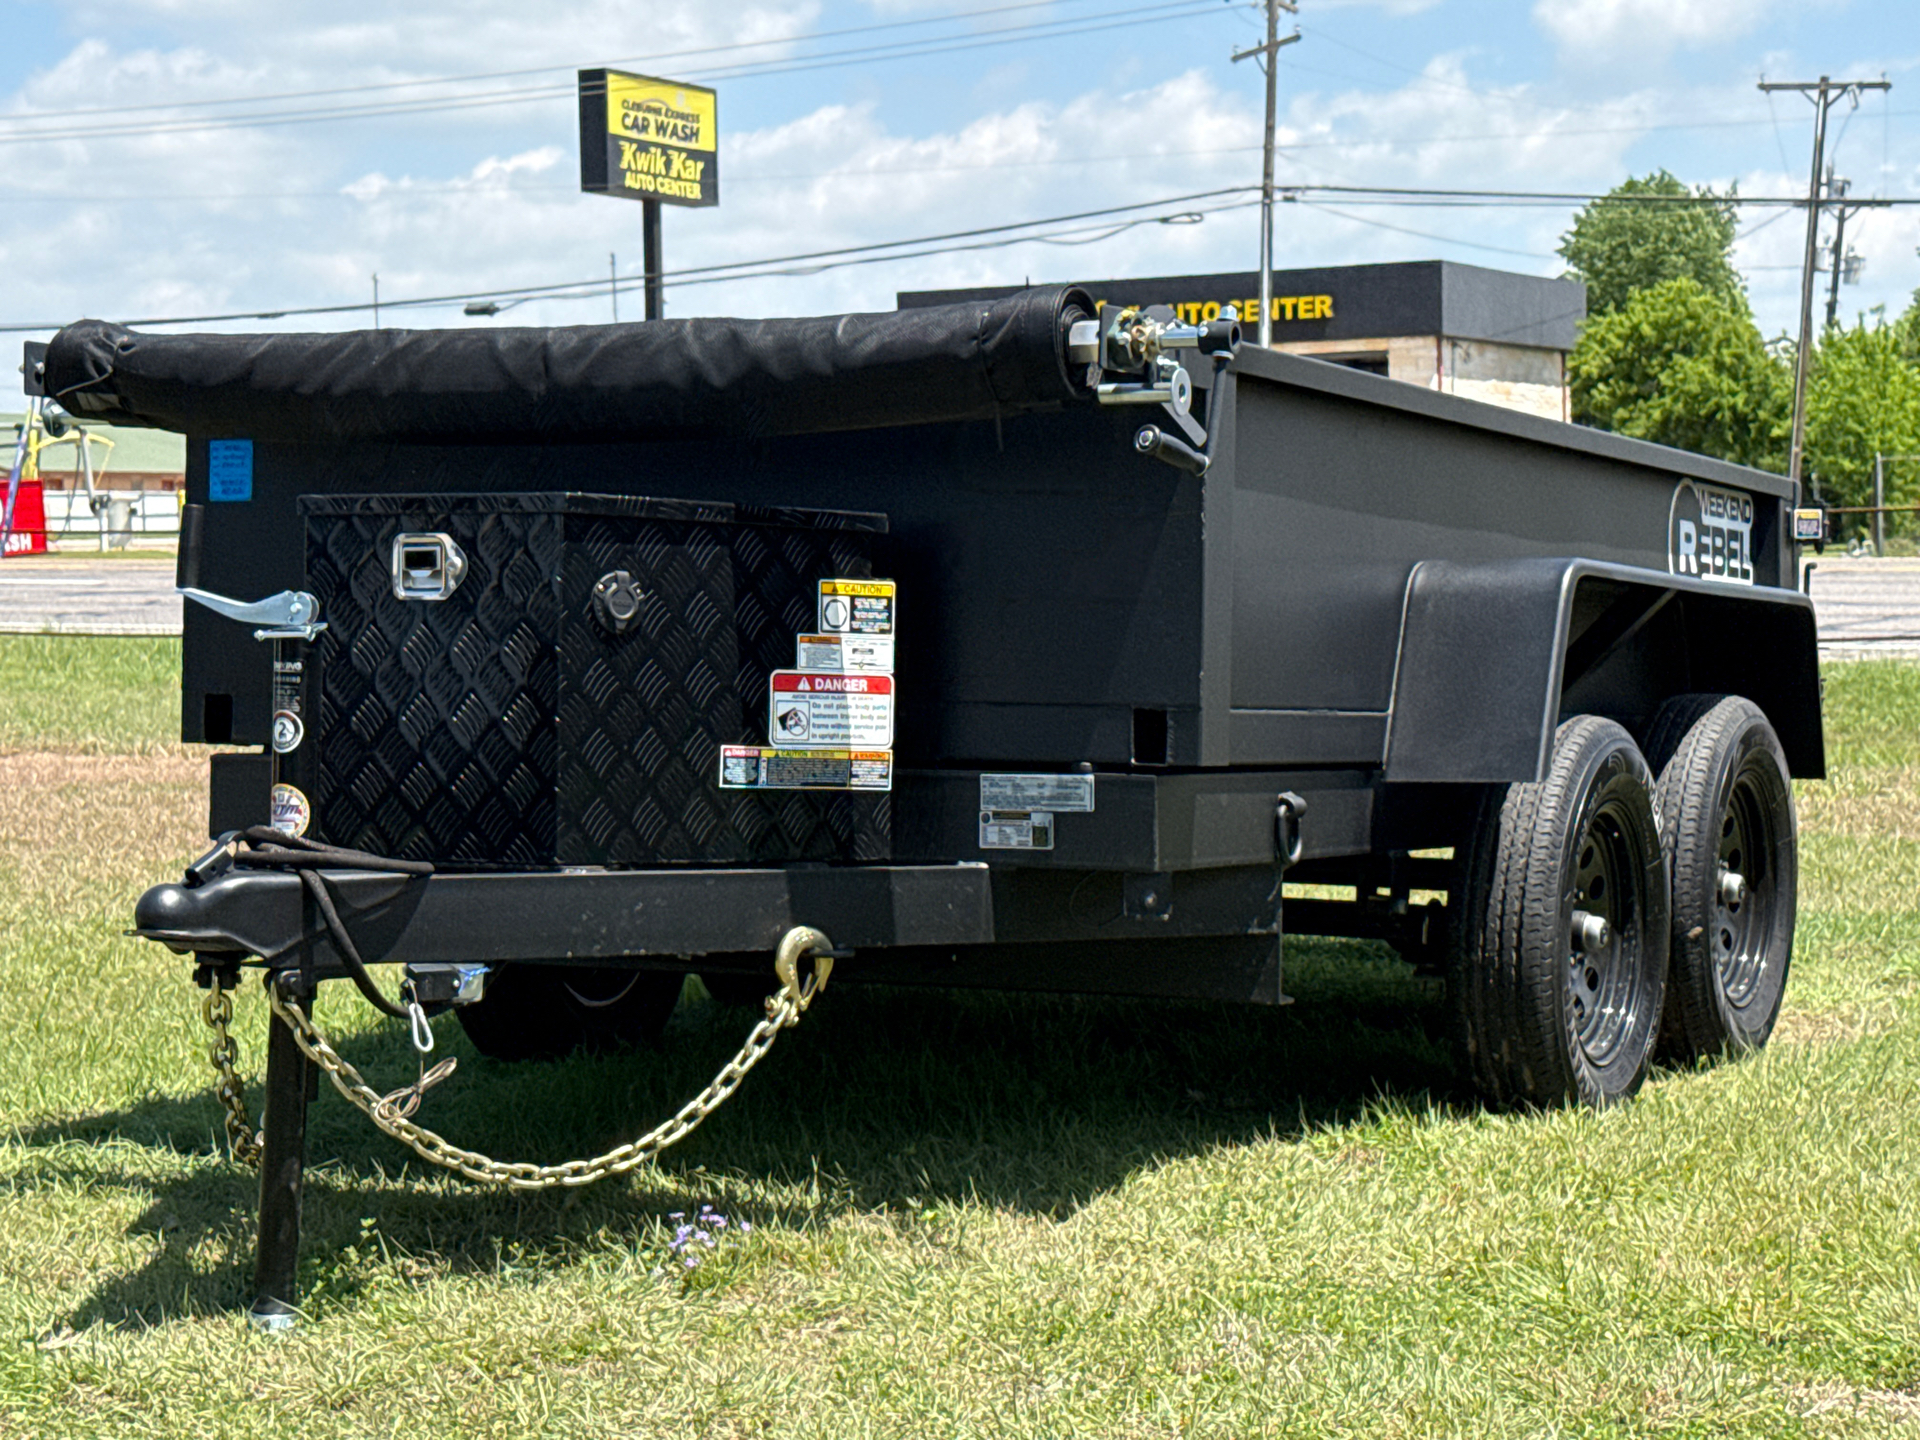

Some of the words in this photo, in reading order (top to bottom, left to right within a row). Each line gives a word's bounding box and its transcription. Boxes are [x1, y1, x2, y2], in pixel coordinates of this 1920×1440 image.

[664, 107, 700, 124] EXPRESS
[621, 112, 650, 135] CAR
[654, 117, 700, 143] WASH
[619, 140, 667, 176] Kwik
[667, 149, 705, 181] Kar
[624, 171, 656, 193] AUTO
[656, 176, 702, 200] CENTER
[1698, 489, 1751, 524] WEEKEND
[1679, 519, 1751, 580] REBEL
[844, 584, 882, 595] CAUTION
[814, 678, 868, 692] DANGER
[855, 703, 870, 711] body
[860, 713, 874, 721] body
[818, 732, 839, 741] upright
[731, 748, 759, 757] DANGER
[781, 750, 808, 758] CAUTION
